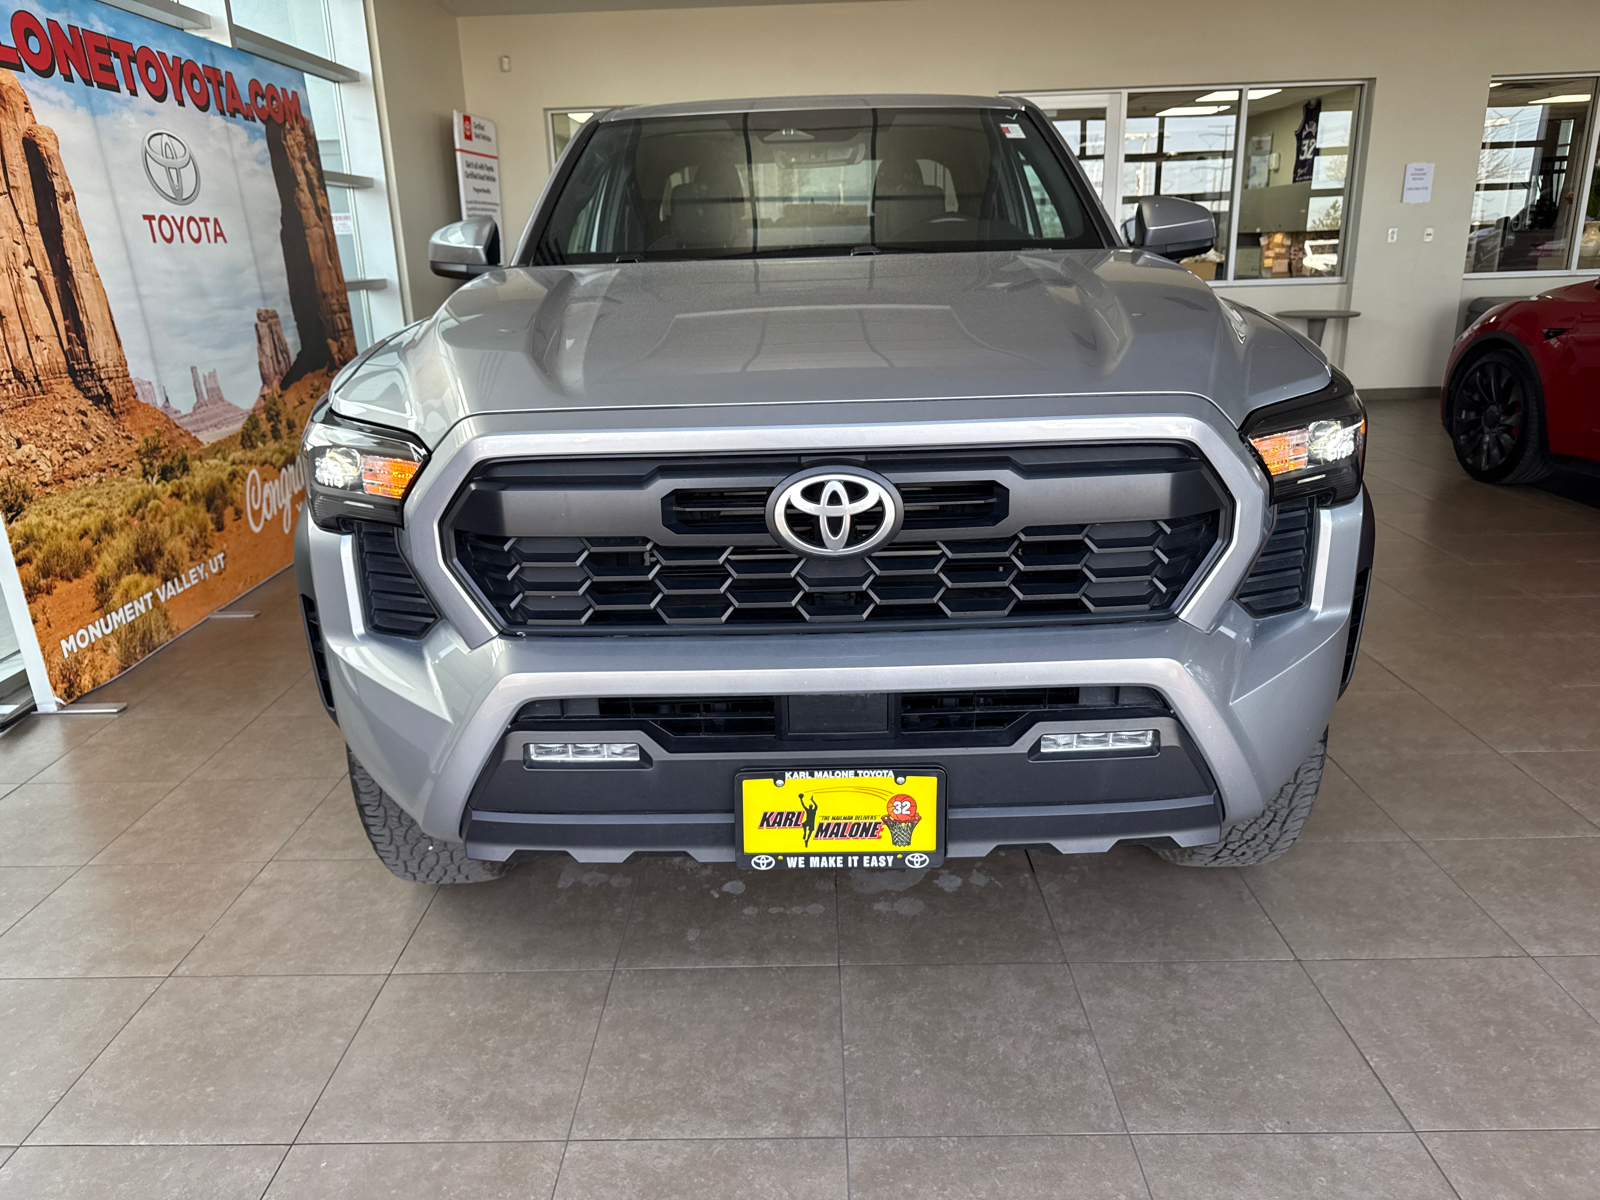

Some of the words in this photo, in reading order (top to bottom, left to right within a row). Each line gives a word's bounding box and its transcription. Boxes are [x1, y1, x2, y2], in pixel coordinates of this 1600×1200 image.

[1299, 139, 1316, 160] 32
[142, 214, 228, 244] TOYOTA
[245, 455, 306, 535] Congra
[60, 591, 154, 659] MONUMENT
[156, 564, 210, 603] VALLEY,
[208, 552, 226, 575] UT
[785, 771, 812, 780] KARL
[814, 770, 855, 779] MALONE
[857, 769, 895, 779] TOYOTA
[892, 801, 911, 815] 32
[758, 810, 806, 829] KARL
[813, 821, 884, 840] MALONE
[787, 856, 807, 868] WE
[810, 856, 843, 868] MAKE
[848, 856, 860, 868] IT
[863, 855, 893, 867] EASY
